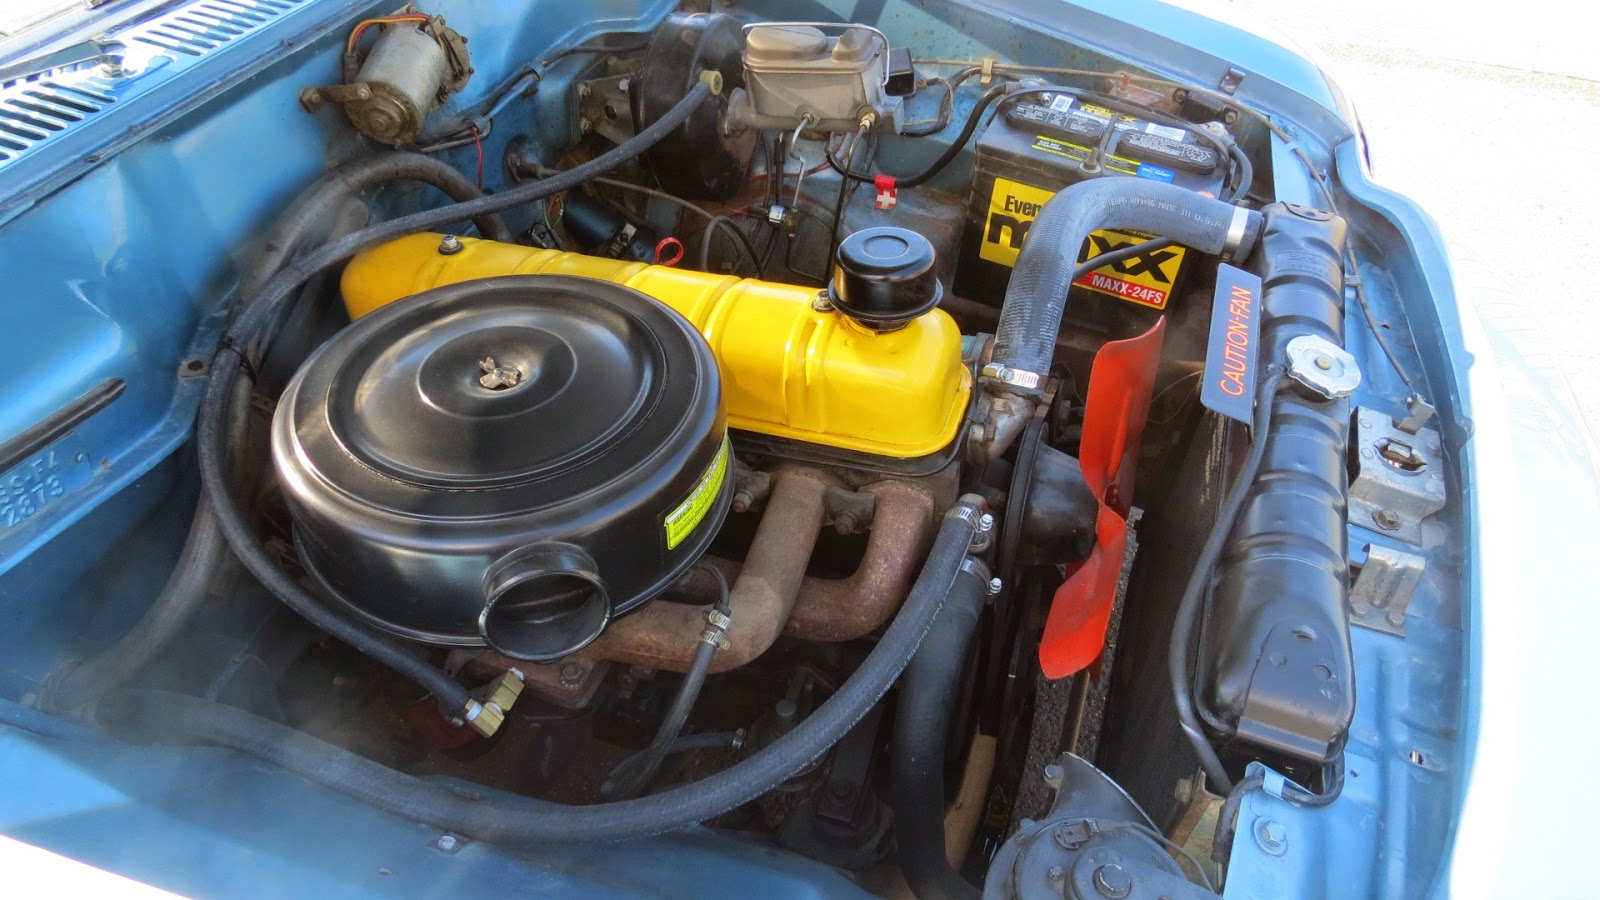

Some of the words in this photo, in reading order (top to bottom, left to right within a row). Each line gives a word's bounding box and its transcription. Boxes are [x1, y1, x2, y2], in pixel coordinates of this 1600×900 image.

[1091, 274, 1163, 304] MAXX-24FS
[1219, 285, 1251, 396] CAUTION-FAN
[1, 475, 63, 528] 2873
